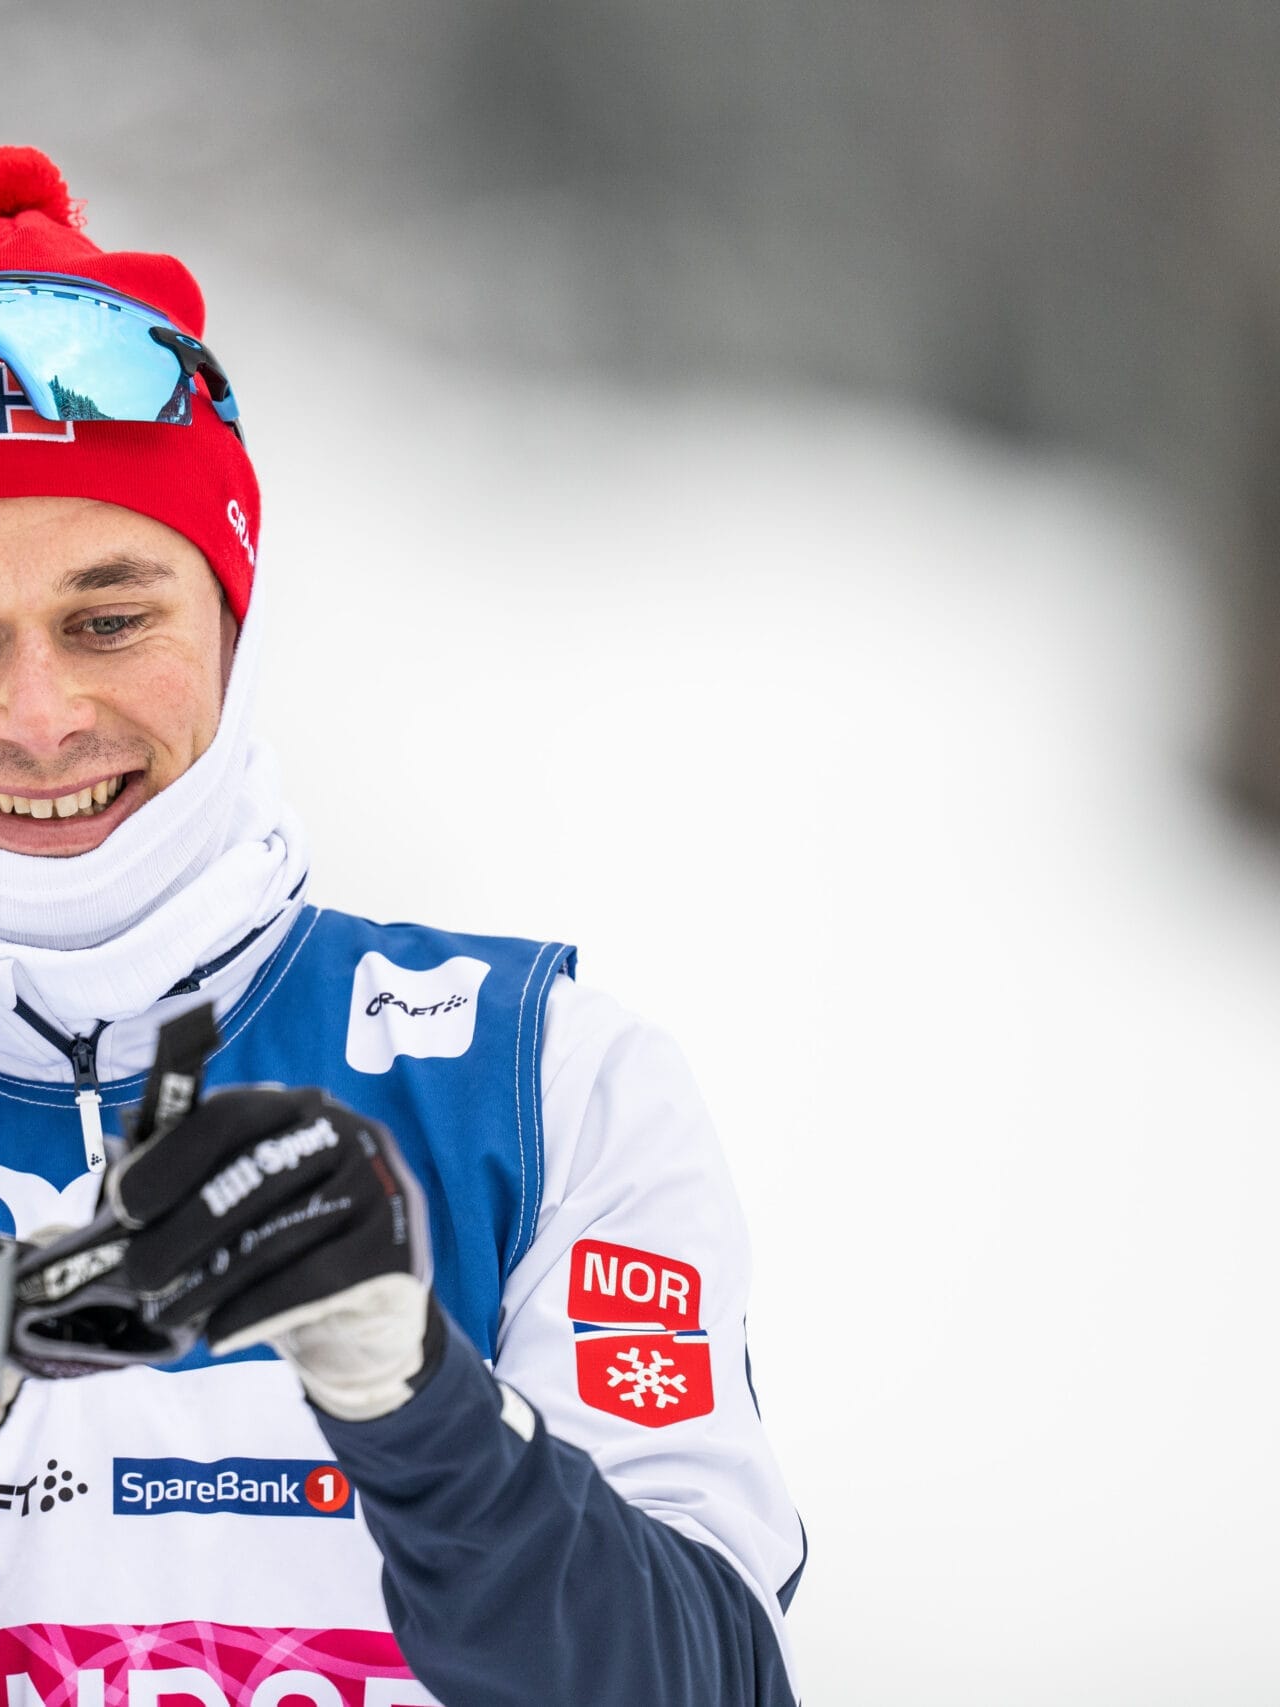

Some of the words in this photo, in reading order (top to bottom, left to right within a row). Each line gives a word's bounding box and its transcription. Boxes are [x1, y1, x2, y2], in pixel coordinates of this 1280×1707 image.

[365, 992, 445, 1017] CRAFT
[583, 1252, 690, 1315] NOR
[122, 1471, 300, 1510] SpareBank
